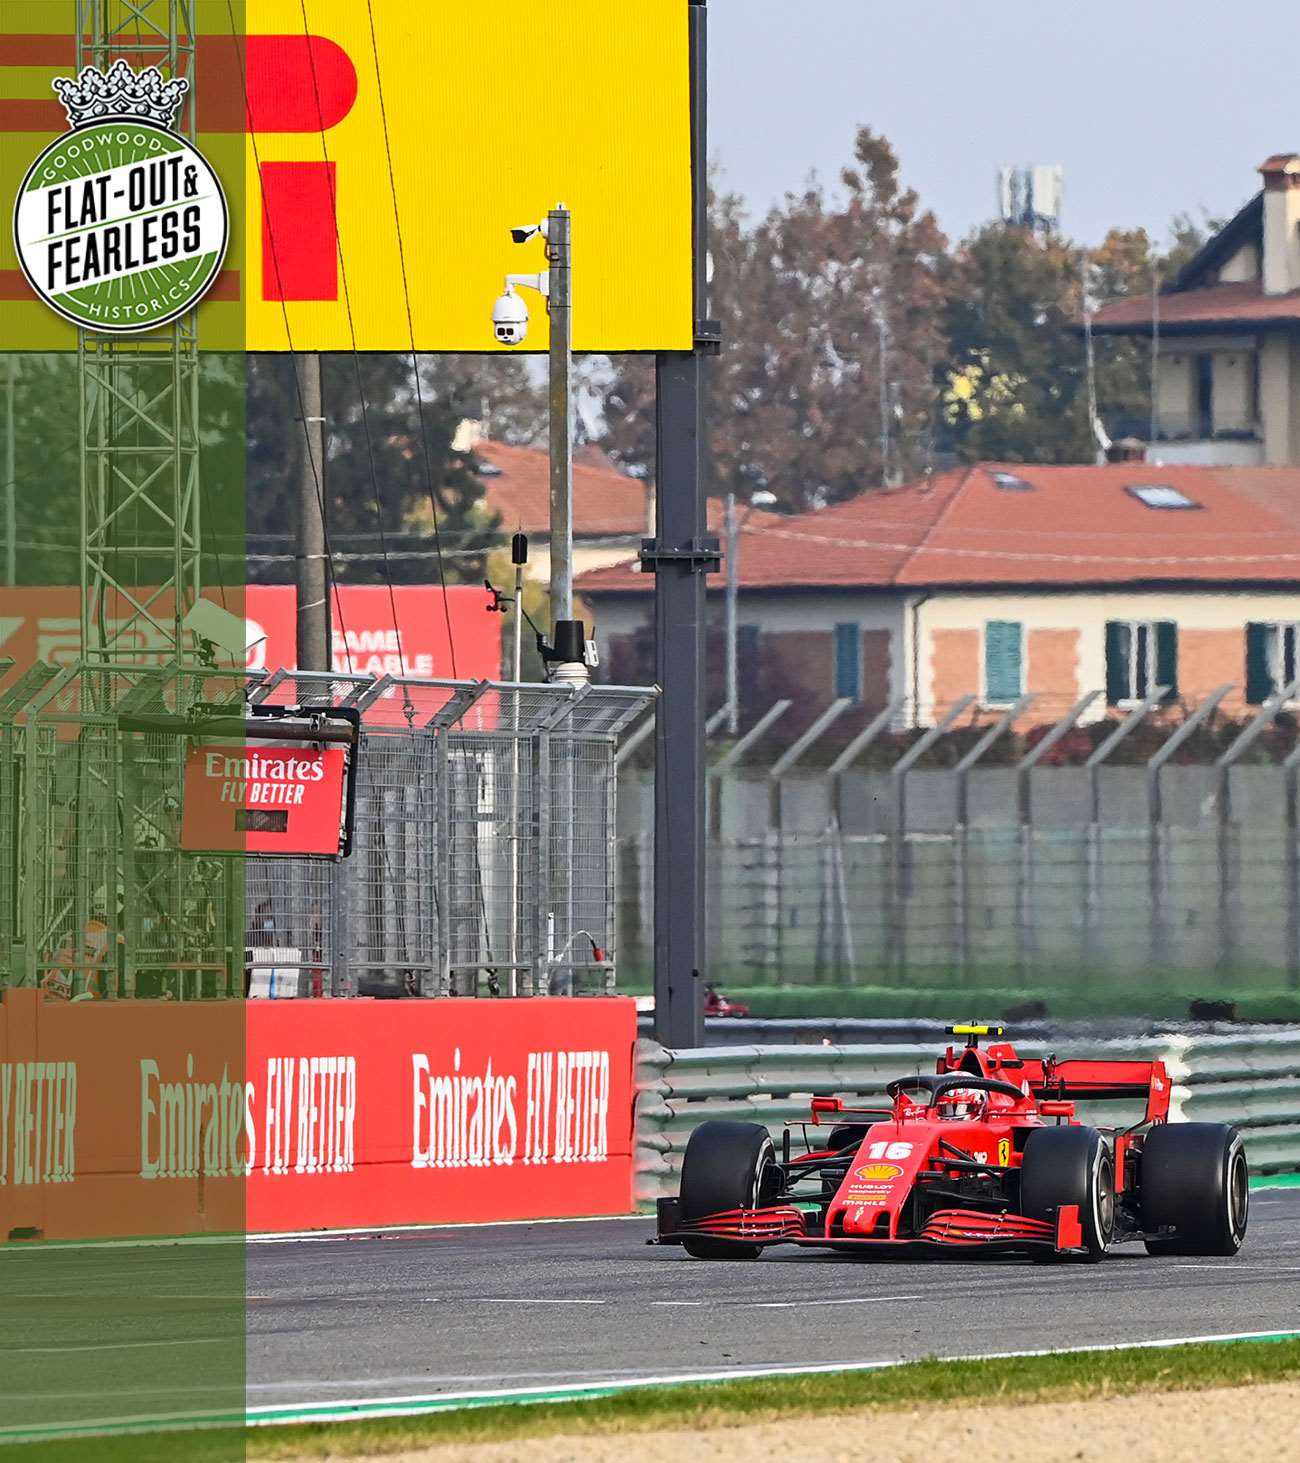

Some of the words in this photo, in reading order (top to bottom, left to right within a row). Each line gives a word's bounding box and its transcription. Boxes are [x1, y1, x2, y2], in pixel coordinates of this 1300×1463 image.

[205, 752, 324, 781] Emirates
[220, 781, 247, 802] FLY
[250, 782, 305, 804] BETTER
[13, 1062, 77, 1184] BETTER
[140, 1053, 256, 1179] Emirates
[263, 1058, 294, 1176] FLY
[295, 1056, 356, 1174] BETTER
[411, 1047, 517, 1168] Emirates
[522, 1052, 553, 1165] FLY
[552, 1051, 610, 1163] BETTER
[868, 1141, 914, 1160] 16
